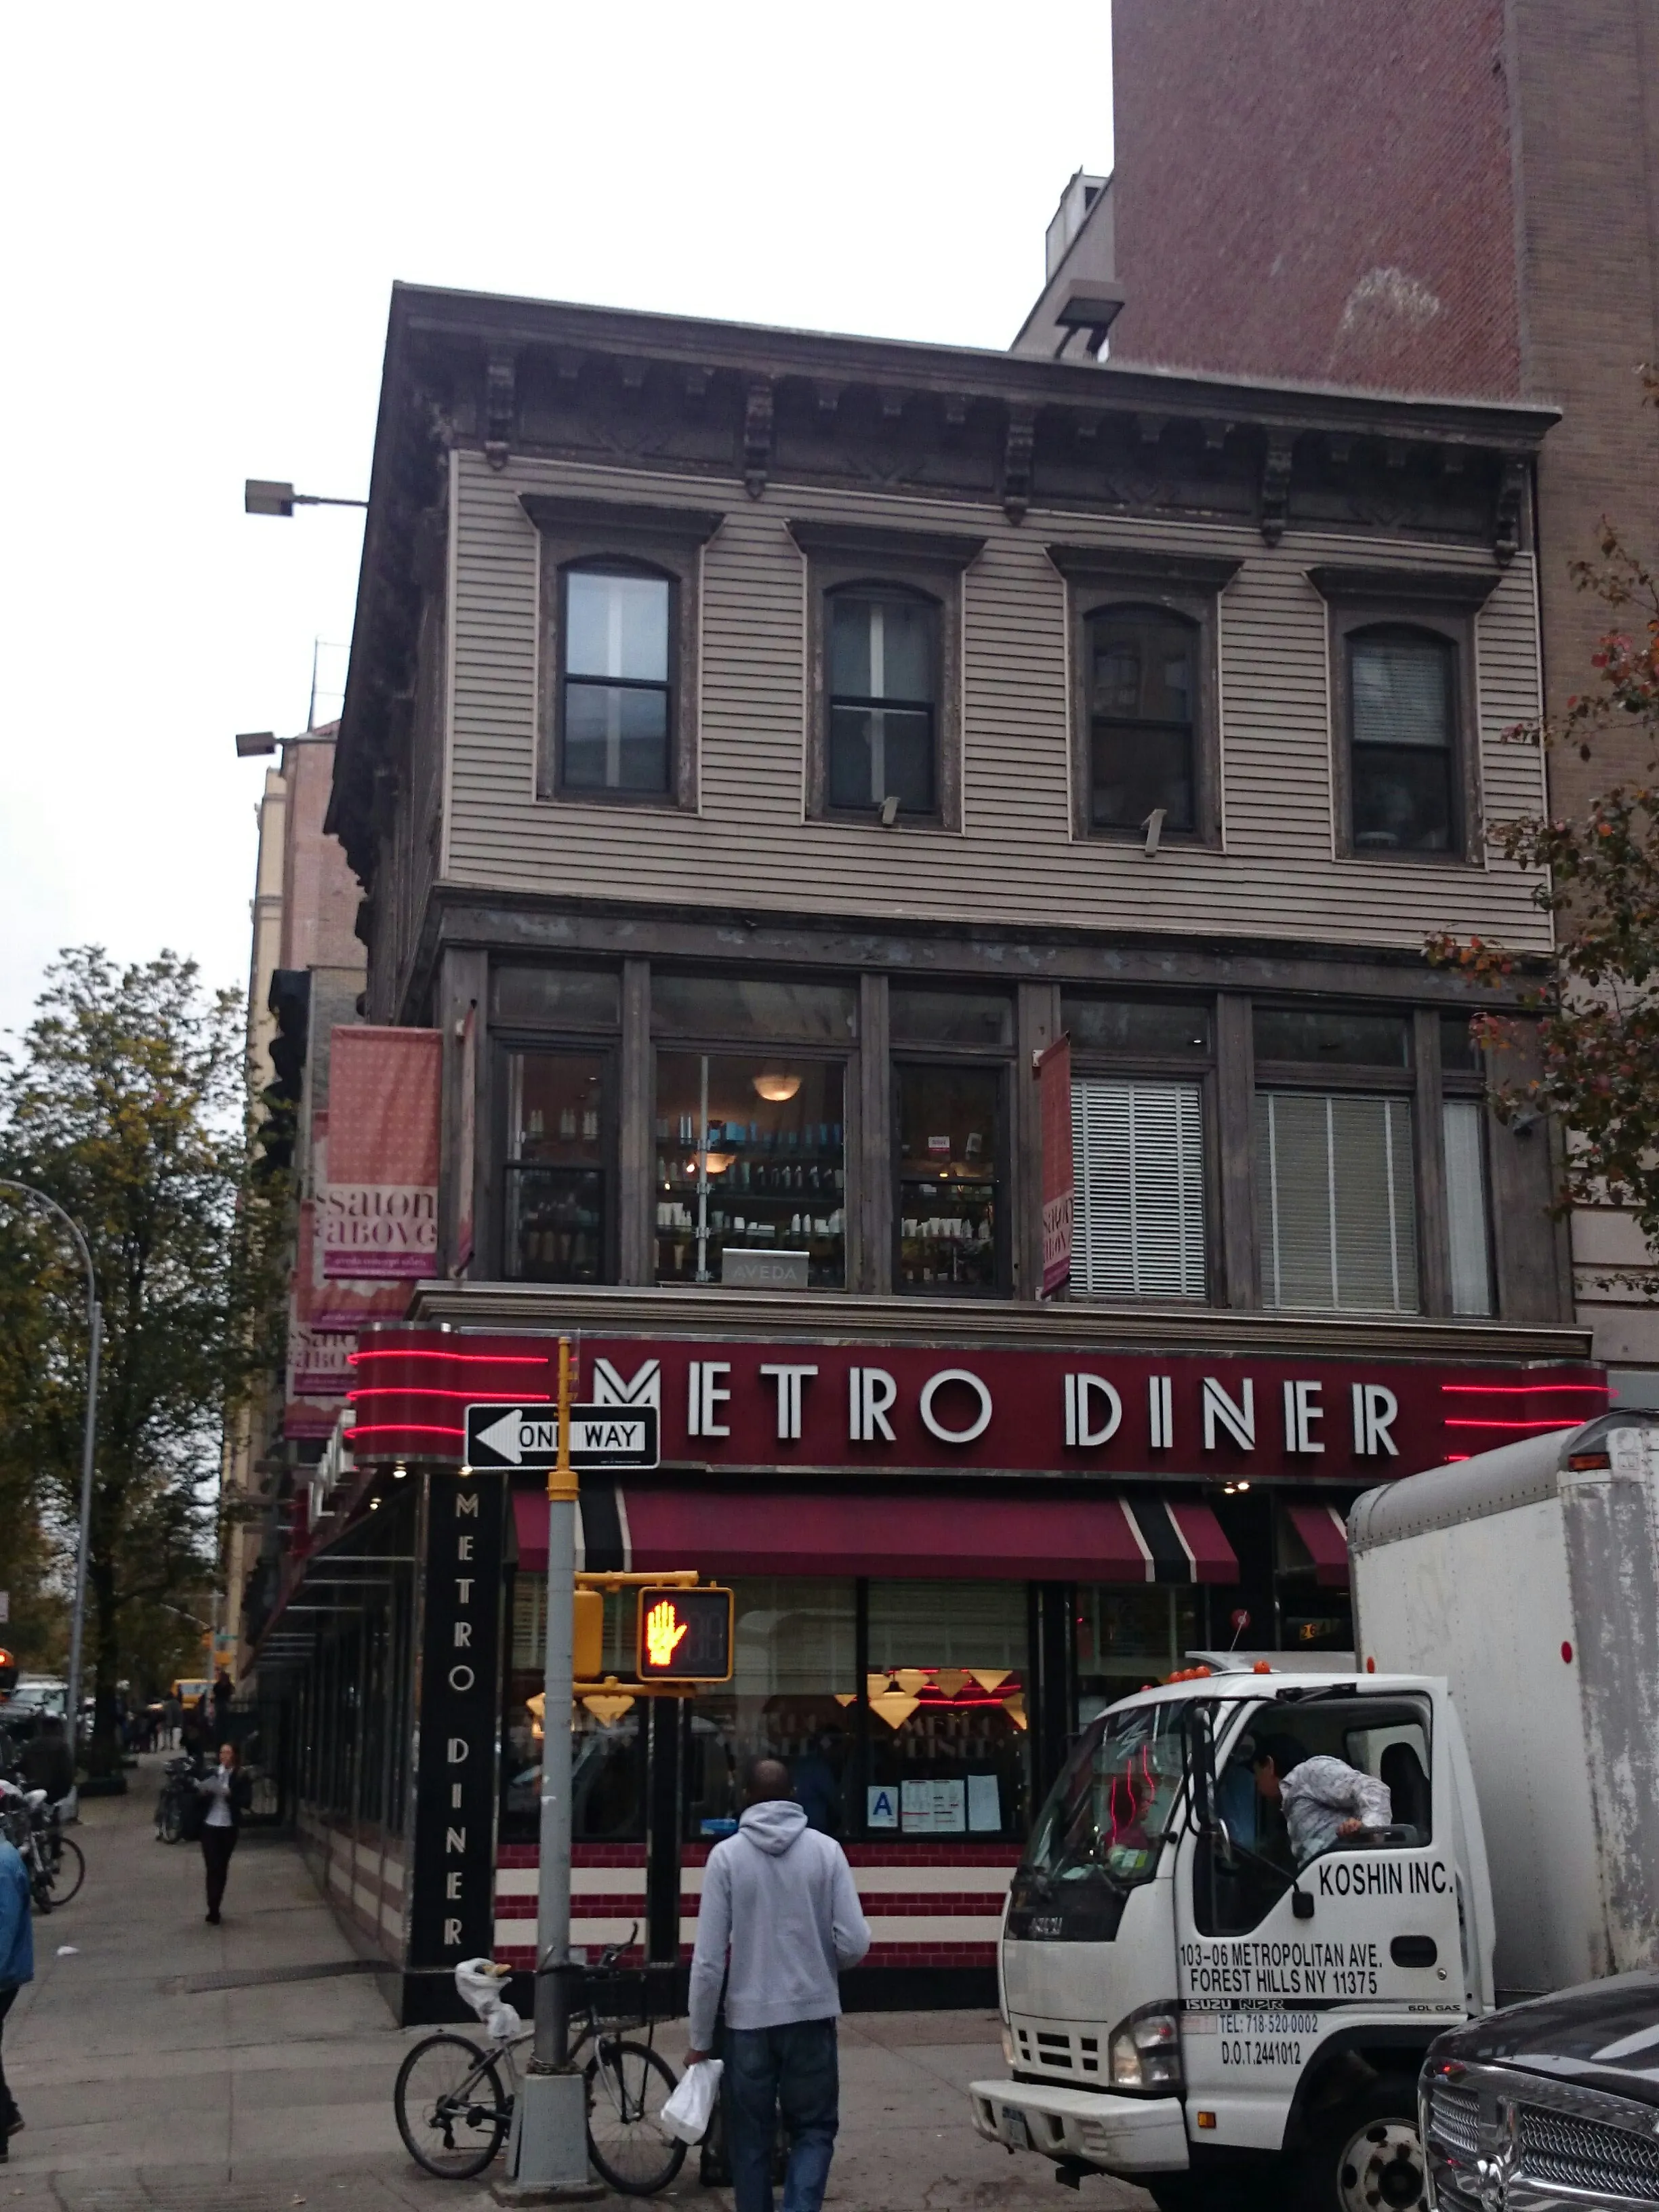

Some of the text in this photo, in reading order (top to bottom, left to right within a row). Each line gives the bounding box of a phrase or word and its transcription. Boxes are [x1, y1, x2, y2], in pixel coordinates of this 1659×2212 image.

[733, 1265, 798, 1280] AVEDA
[594, 1358, 1400, 1456] METRO DINER
[585, 1425, 638, 1448] WAY
[448, 1494, 478, 1691] METRO
[873, 1791, 893, 1816] A
[444, 1737, 470, 1946] DINER
[1319, 1861, 1454, 1896] KOSHIN INC.
[1180, 1943, 1383, 1968] 103-06 METROPOLITAN AVE.
[1190, 1969, 1378, 1994] FOREST HILLS NY 11375
[1186, 1999, 1286, 2010] ISUZU NPR
[1221, 2013, 1244, 2033] TEL:
[1246, 2012, 1318, 2033] 718-520-0002
